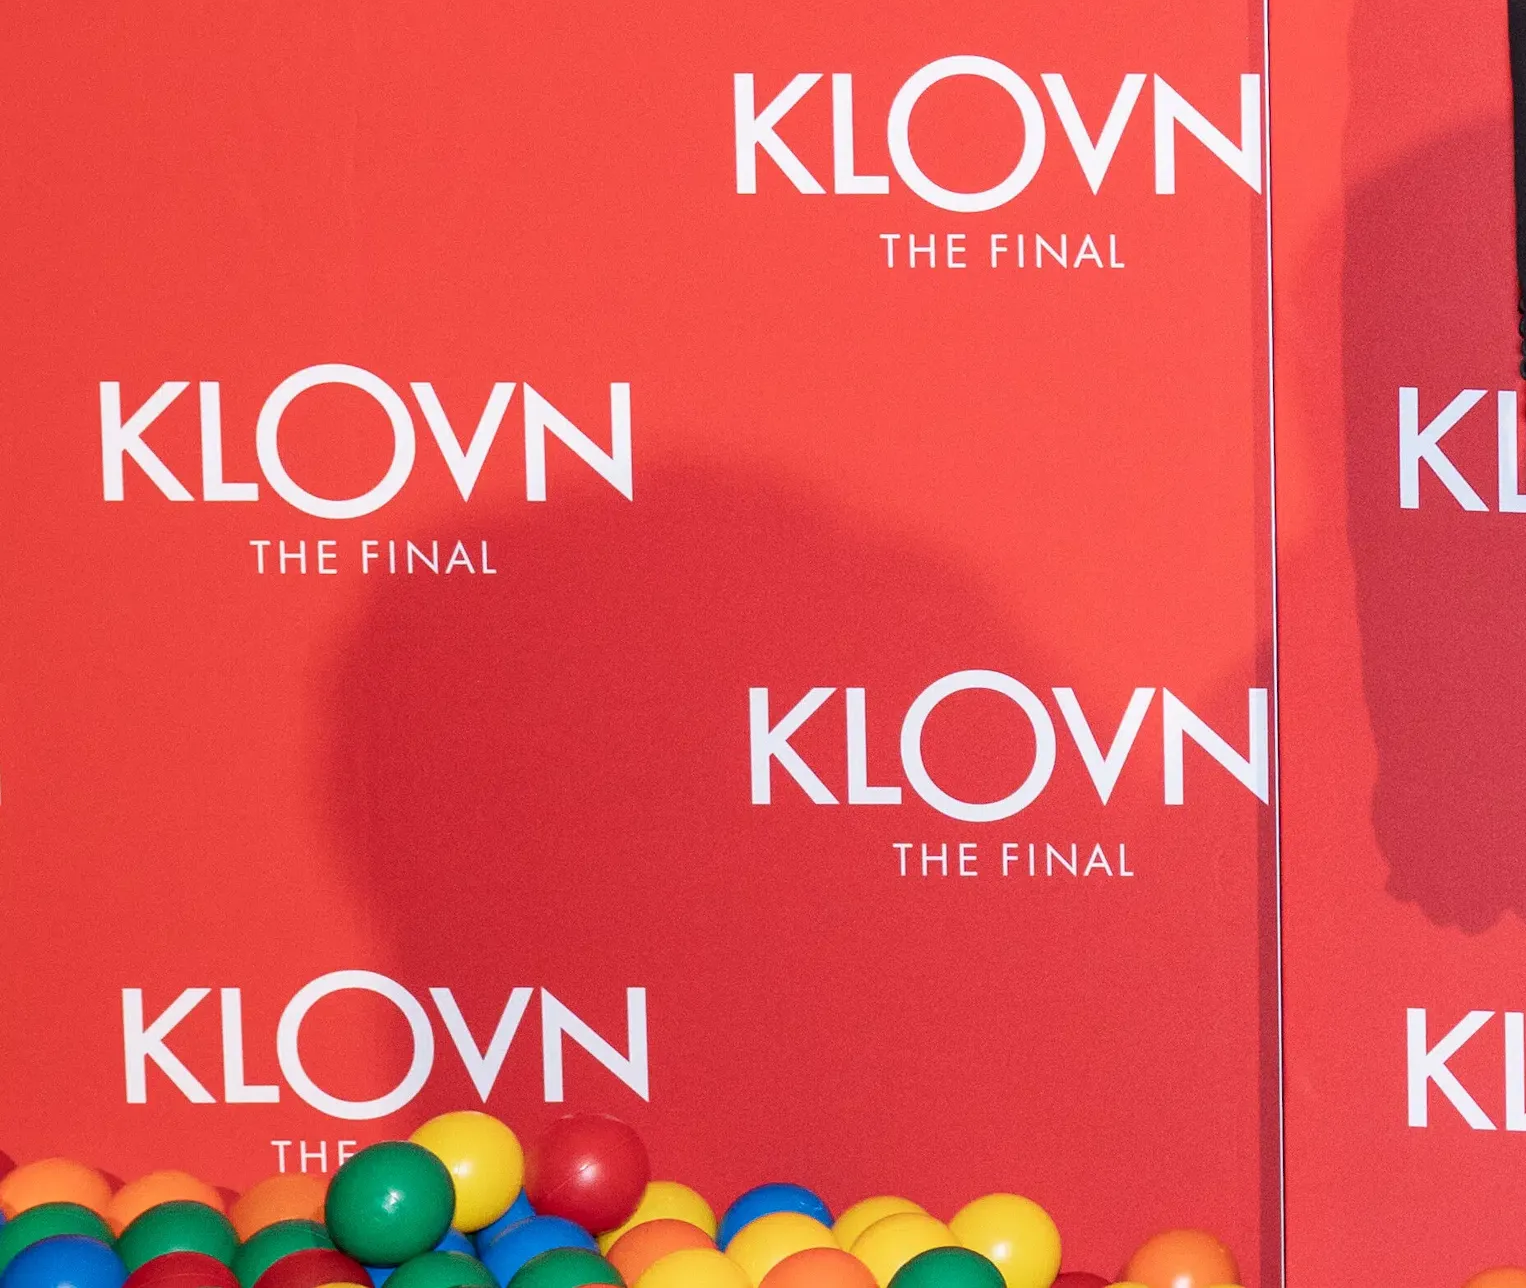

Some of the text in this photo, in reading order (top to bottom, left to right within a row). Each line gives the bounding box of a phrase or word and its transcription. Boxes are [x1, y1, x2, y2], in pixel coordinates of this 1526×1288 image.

[734, 54, 1262, 213] KLOVN
[880, 233, 1126, 269] THE FINAL
[100, 363, 633, 520] KLOVN
[250, 539, 497, 575] THE FINAL
[749, 669, 1269, 823] KLOVN
[893, 842, 1135, 878] THE FINAL
[122, 969, 650, 1121] KLOVN
